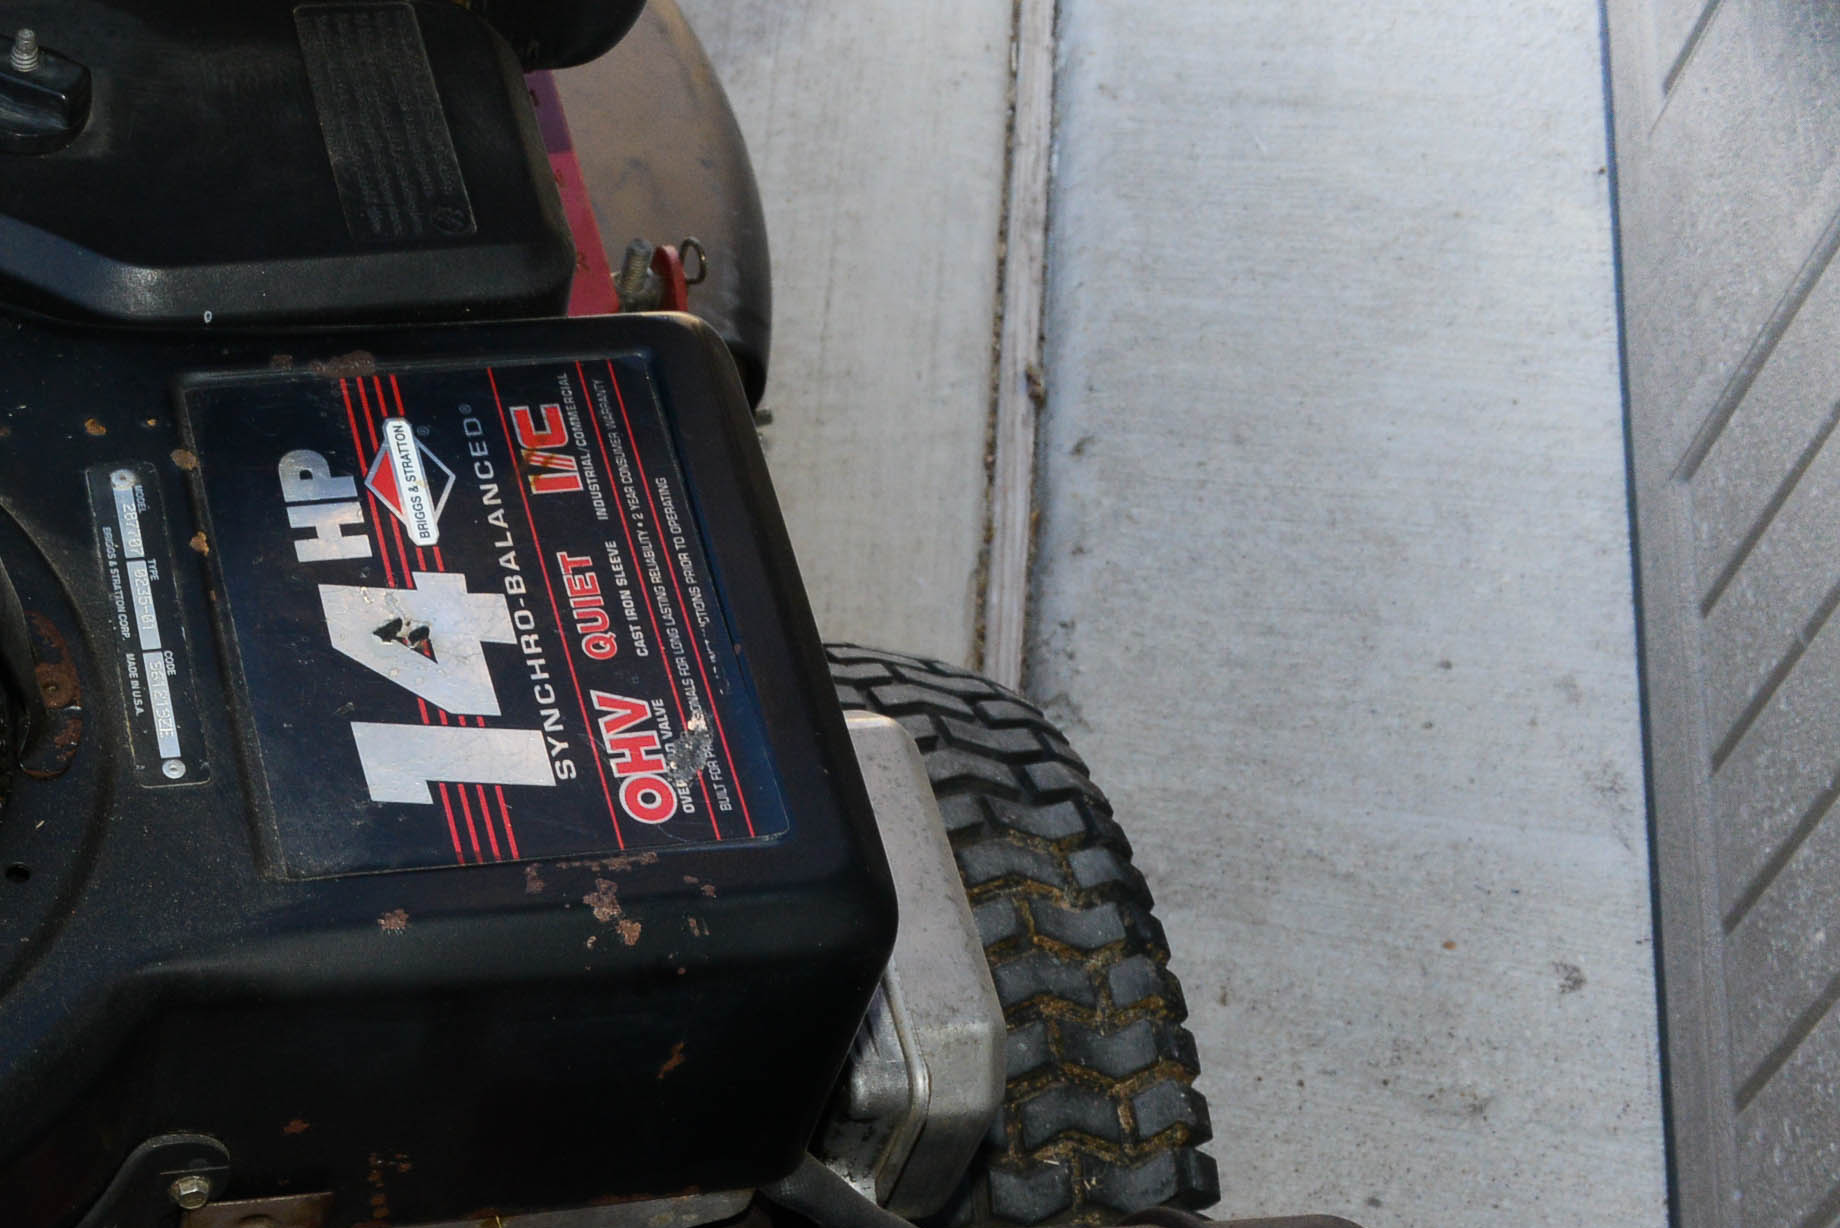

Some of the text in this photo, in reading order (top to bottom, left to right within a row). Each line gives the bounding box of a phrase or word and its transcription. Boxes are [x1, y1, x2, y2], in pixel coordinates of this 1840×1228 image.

[592, 379, 616, 429] WARRANTY
[557, 373, 608, 520] INDUSTRIAL/COMMERCIAL
[607, 431, 632, 484] CONSUMER
[278, 449, 373, 562] HP
[392, 424, 431, 539] BRIGGS & STRATTON
[624, 484, 640, 512] YEAR
[655, 477, 679, 534] OPERATING
[631, 512, 644, 520] 2
[102, 526, 117, 560] BRIGGS
[637, 530, 662, 585] RELIABILITY
[672, 536, 687, 551] TO
[110, 568, 127, 613] STRATTON
[134, 485, 176, 676] MODEL TYPE CODE
[678, 552, 696, 585] PRIOR
[134, 568, 155, 630] 0235-01
[556, 551, 618, 660] QUIET
[605, 540, 648, 657] CAST IRON SLEEVE
[653, 585, 676, 626] LASTING
[117, 613, 131, 640] CORP.
[666, 627, 684, 655] LONG
[126, 653, 144, 716] MADE IN U.S.A.
[317, 571, 557, 805] 14
[675, 656, 691, 678] FOR
[651, 698, 674, 739] VALVE
[590, 689, 678, 824] OHV
[707, 760, 723, 782] FOR
[713, 784, 732, 812] BUILT
